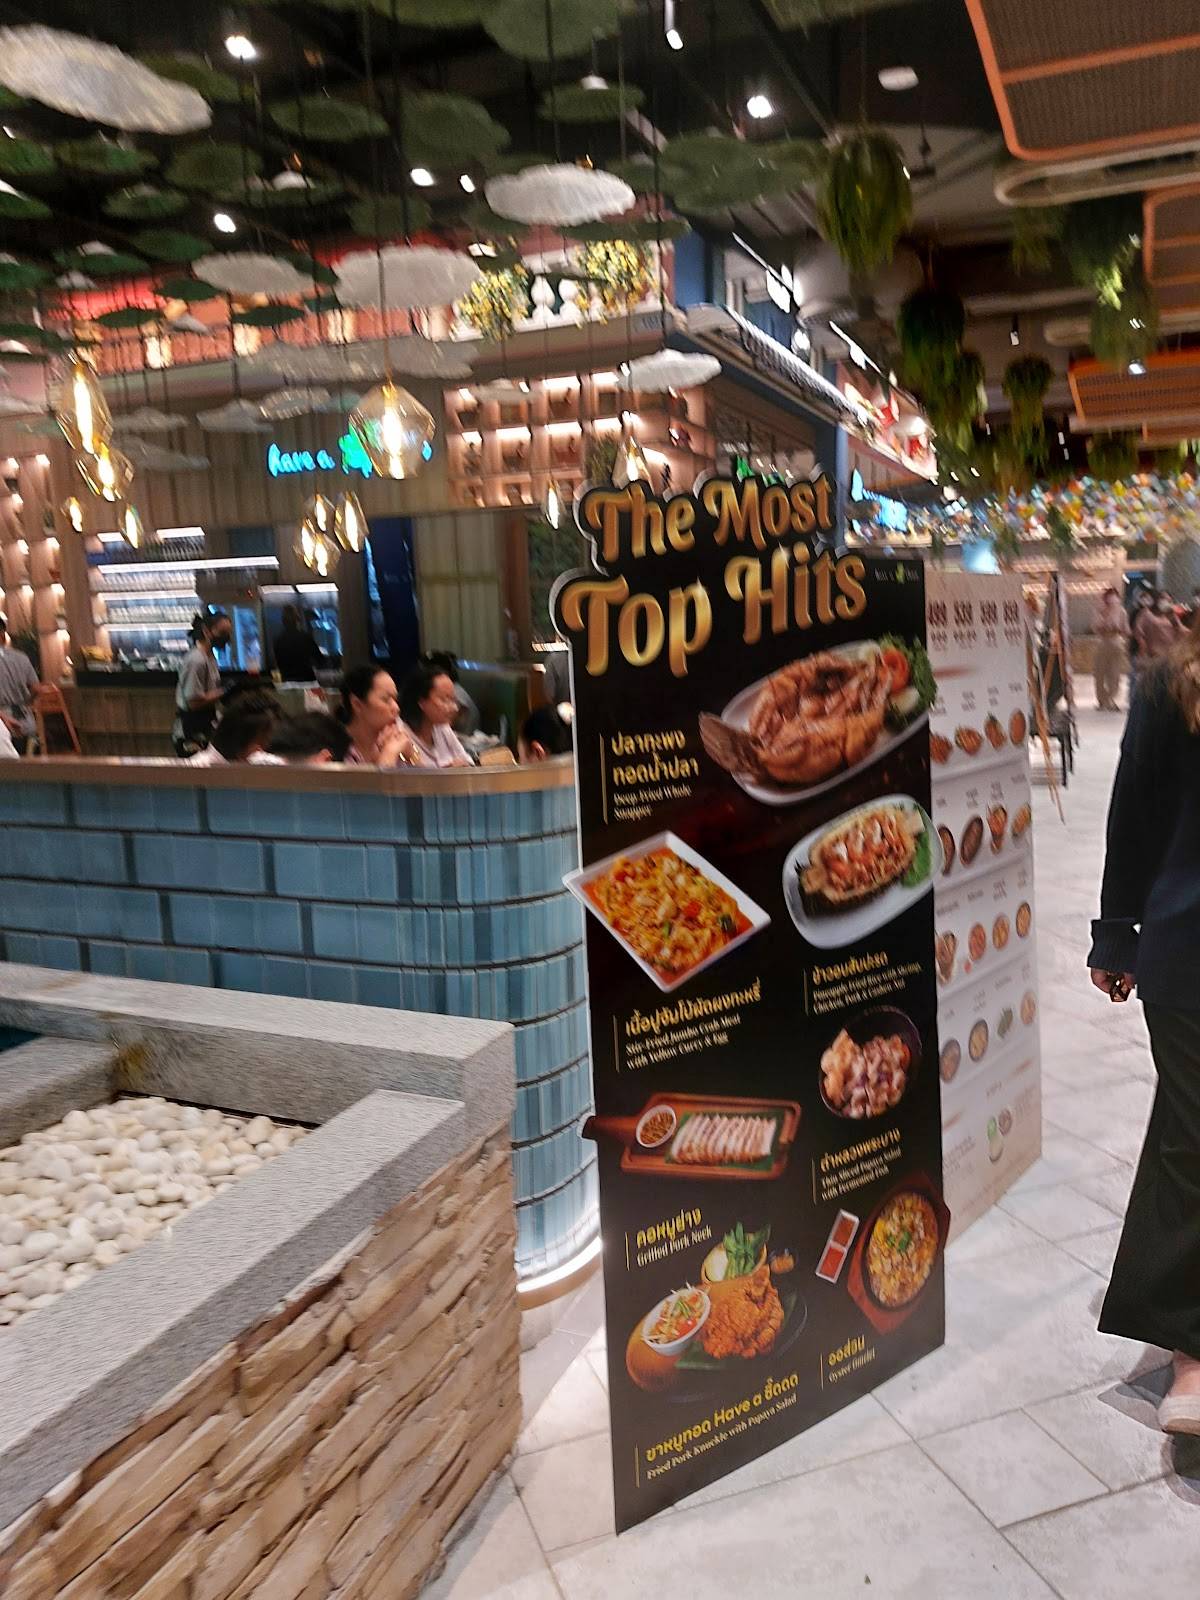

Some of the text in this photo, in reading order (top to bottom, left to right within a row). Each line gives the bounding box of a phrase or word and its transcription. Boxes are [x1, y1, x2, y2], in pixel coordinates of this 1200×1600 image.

[585, 476, 832, 563] The Most
[561, 541, 867, 678] Top Hits
[611, 730, 686, 756] ปลากะพง
[613, 751, 699, 786] ทอดน้ำปลา
[637, 1208, 702, 1248] คอหมูย่าง
[646, 1419, 712, 1462] ขาหมูทอด
[714, 1400, 750, 1427] Have
[753, 1393, 762, 1407] a
[647, 1459, 671, 1480] Fried
[671, 1450, 692, 1467] Pork
[693, 1432, 728, 1457] Knuckle
[729, 1421, 747, 1437] with
